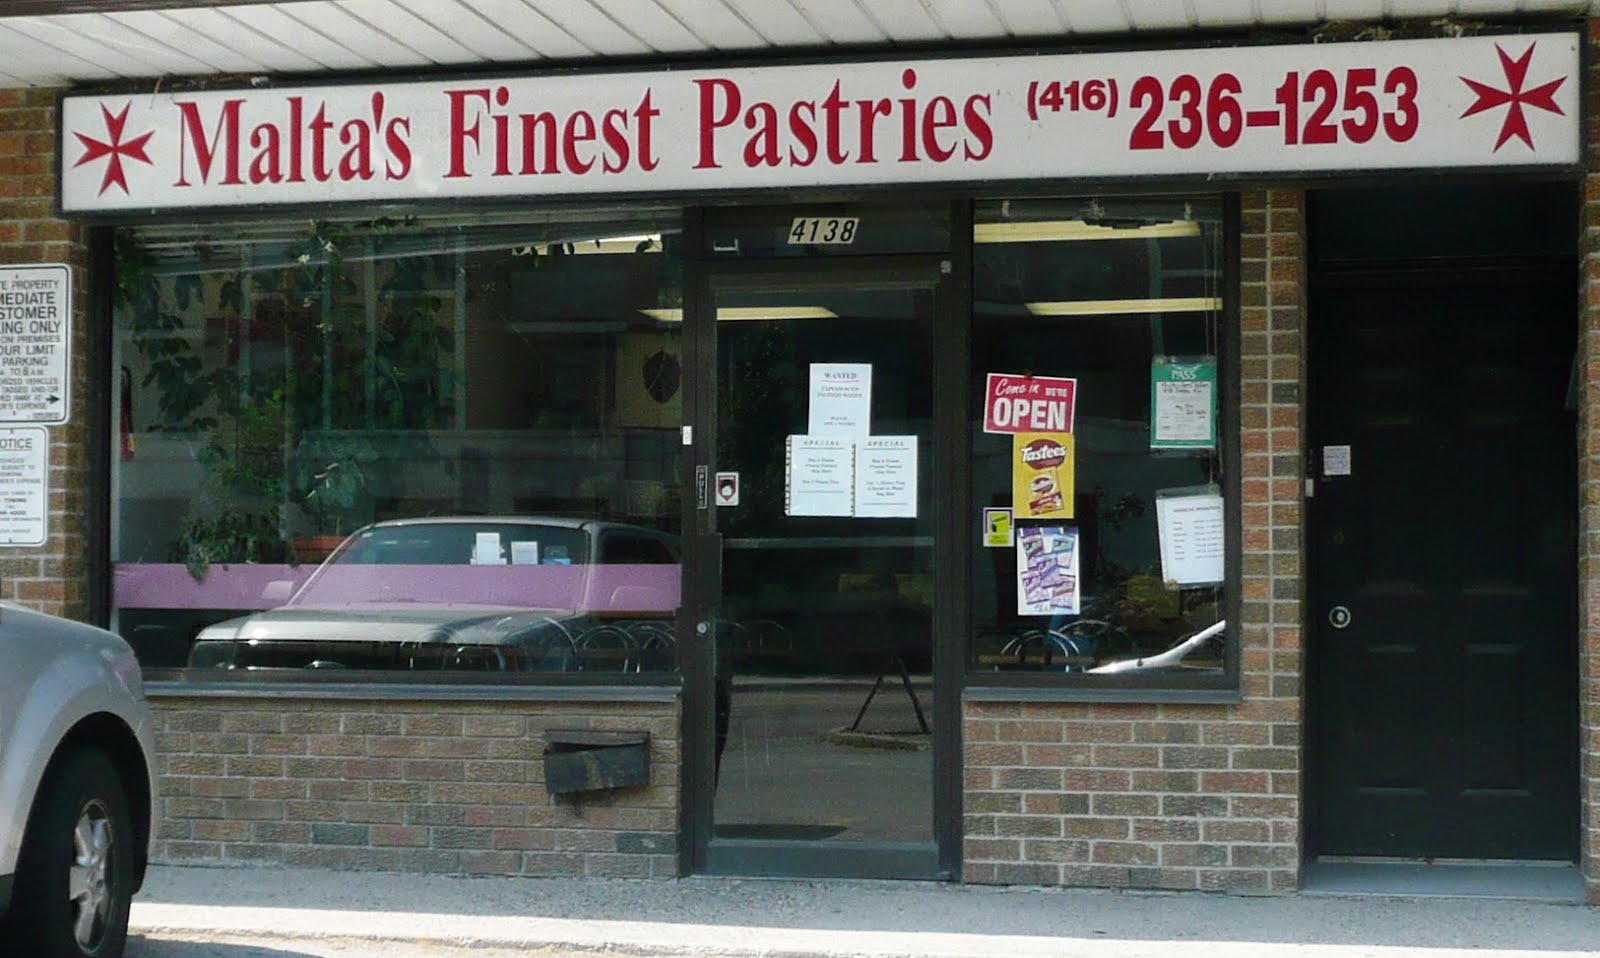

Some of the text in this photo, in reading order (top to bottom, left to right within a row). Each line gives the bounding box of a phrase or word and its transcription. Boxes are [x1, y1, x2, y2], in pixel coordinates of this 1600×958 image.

[1027, 66, 1419, 150] (416) 236-1253
[173, 68, 994, 187] Malta's Finest Pastries
[791, 219, 856, 242] 4138
[11, 279, 59, 290] PROPERTY
[0, 306, 57, 320] STOMER
[0, 320, 61, 334] ING ONLY
[26, 344, 55, 355] LIMIT
[2, 356, 48, 367] PARKING
[1171, 369, 1197, 380] PASS
[995, 377, 1068, 398] Come in WE'RE
[992, 396, 1067, 431] OPEN
[1021, 443, 1068, 463] Tastees
